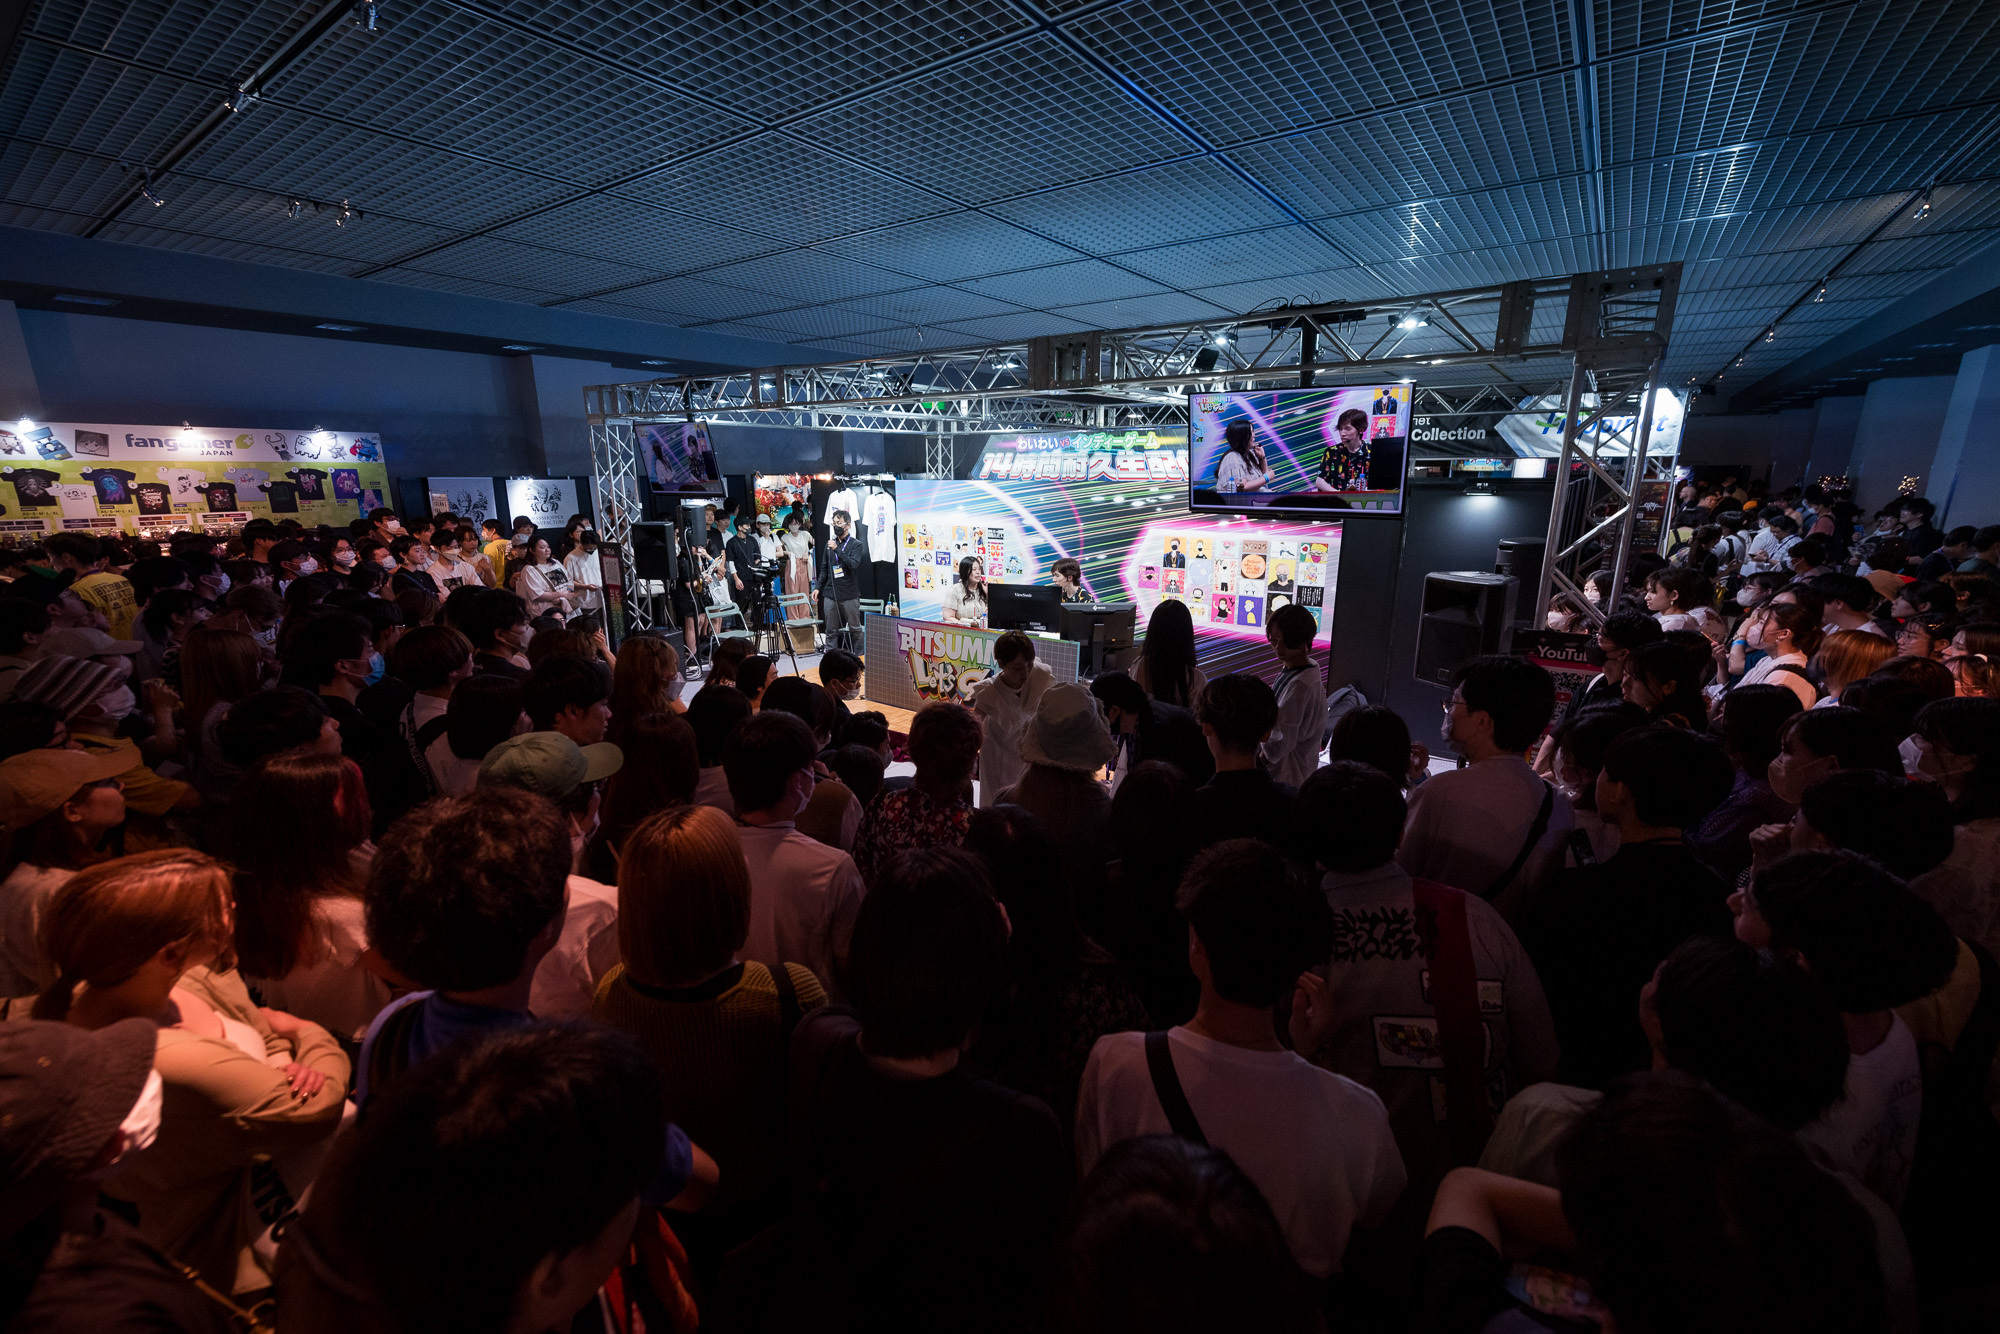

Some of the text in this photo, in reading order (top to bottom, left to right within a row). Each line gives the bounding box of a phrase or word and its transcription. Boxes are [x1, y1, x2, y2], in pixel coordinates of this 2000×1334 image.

[1016, 436, 1059, 451] わいわい
[1072, 431, 1159, 450] インディーゲーム
[1411, 427, 1487, 442] Collection
[909, 648, 957, 695] Let's
